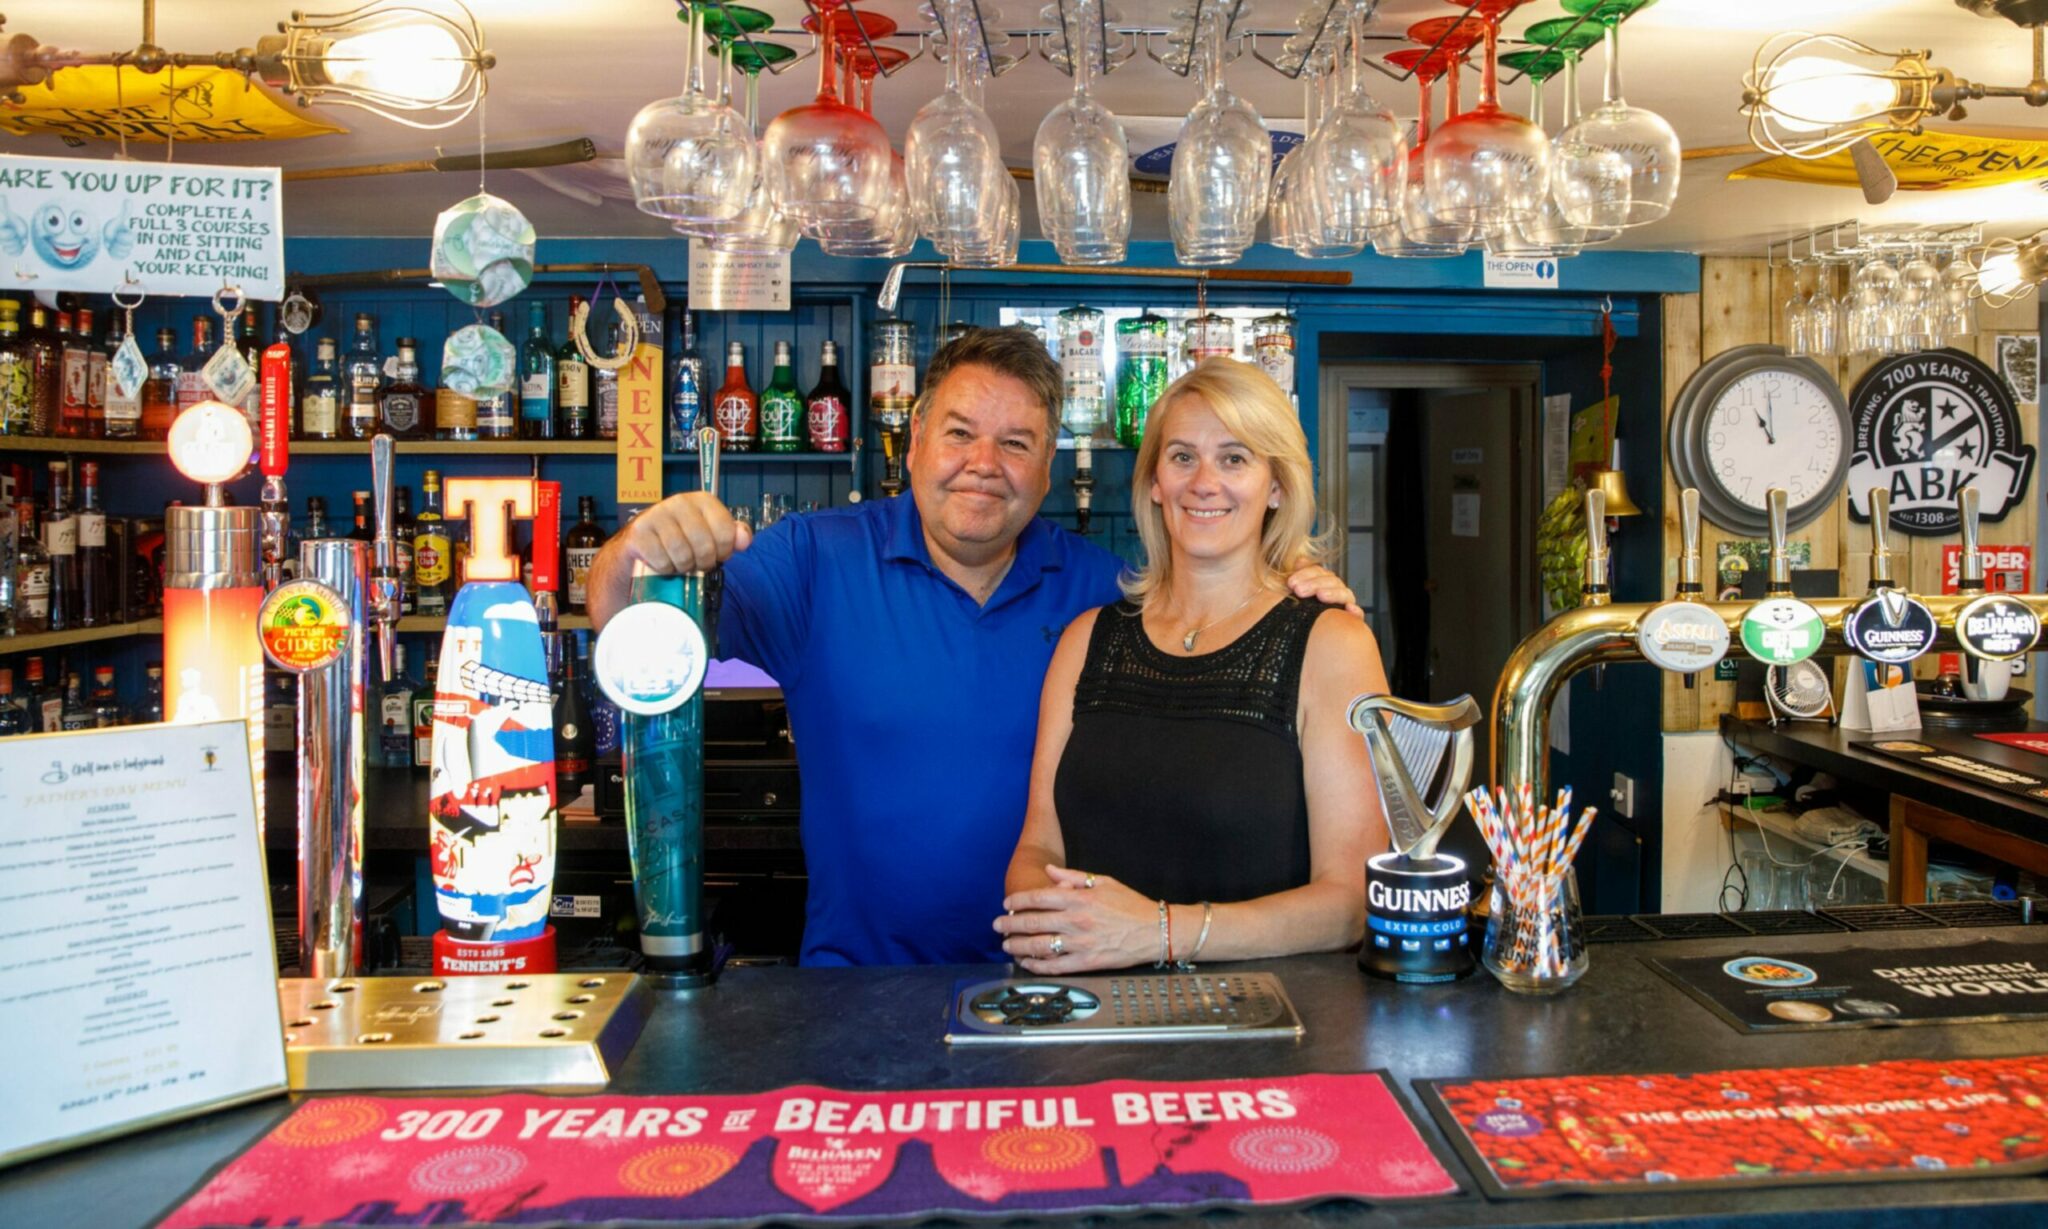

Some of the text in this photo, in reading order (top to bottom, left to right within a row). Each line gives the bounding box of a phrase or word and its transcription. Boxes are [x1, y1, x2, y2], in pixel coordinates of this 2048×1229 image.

[1874, 137, 2039, 172] THE OPEN
[0, 169, 273, 201] ARE YOU UP FOR IT?
[145, 203, 252, 220] COMPLETE A
[129, 217, 270, 235] FULL 3 COURSES
[137, 231, 263, 250] IN ONE SITTING
[154, 248, 246, 263] AND CLAIM
[133, 260, 269, 280] YOUR KEYRING!
[1487, 260, 1534, 272] THE OPEN
[1740, 387, 1755, 407] 11
[1760, 379, 1782, 399] 12
[1792, 386, 1800, 405] 1
[1807, 404, 1821, 425] 2
[1857, 362, 2006, 449] BREWING 700 YEARS TRADITION
[627, 355, 655, 482] NEXT
[1720, 406, 1741, 426] 10
[1712, 431, 1726, 452] 9
[1815, 429, 1829, 449] 3
[1721, 457, 1736, 478] 8
[1807, 455, 1820, 473] 4
[621, 490, 659, 499] PLEASE
[1740, 476, 1753, 495] 7
[1789, 474, 1803, 496] 5
[1889, 467, 1980, 505] ABK
[1914, 511, 1945, 524] 1308
[443, 476, 539, 581] T
[1947, 551, 2026, 570] UDER
[1967, 614, 2035, 636] BELHAVEN
[274, 637, 334, 653] CIDER
[1864, 629, 1925, 644] GUINNESS
[143, 777, 188, 792] MENU
[1384, 919, 1461, 933] EXTRA COLD
[441, 955, 528, 973] TENNENT'S
[1871, 961, 2037, 979] DEFINITELY
[381, 1107, 502, 1141] 300
[517, 1107, 708, 1141] YEARS
[773, 1097, 1095, 1134] BEAUTIFUL
[1112, 1088, 1299, 1127] BEERS
[1622, 1111, 1681, 1125] THE
[1682, 1108, 1731, 1122] GIN
[1732, 1106, 1778, 1120] ON
[1778, 1098, 1949, 1120] EVERYONE'S
[787, 1145, 882, 1161] BELHAVEN
